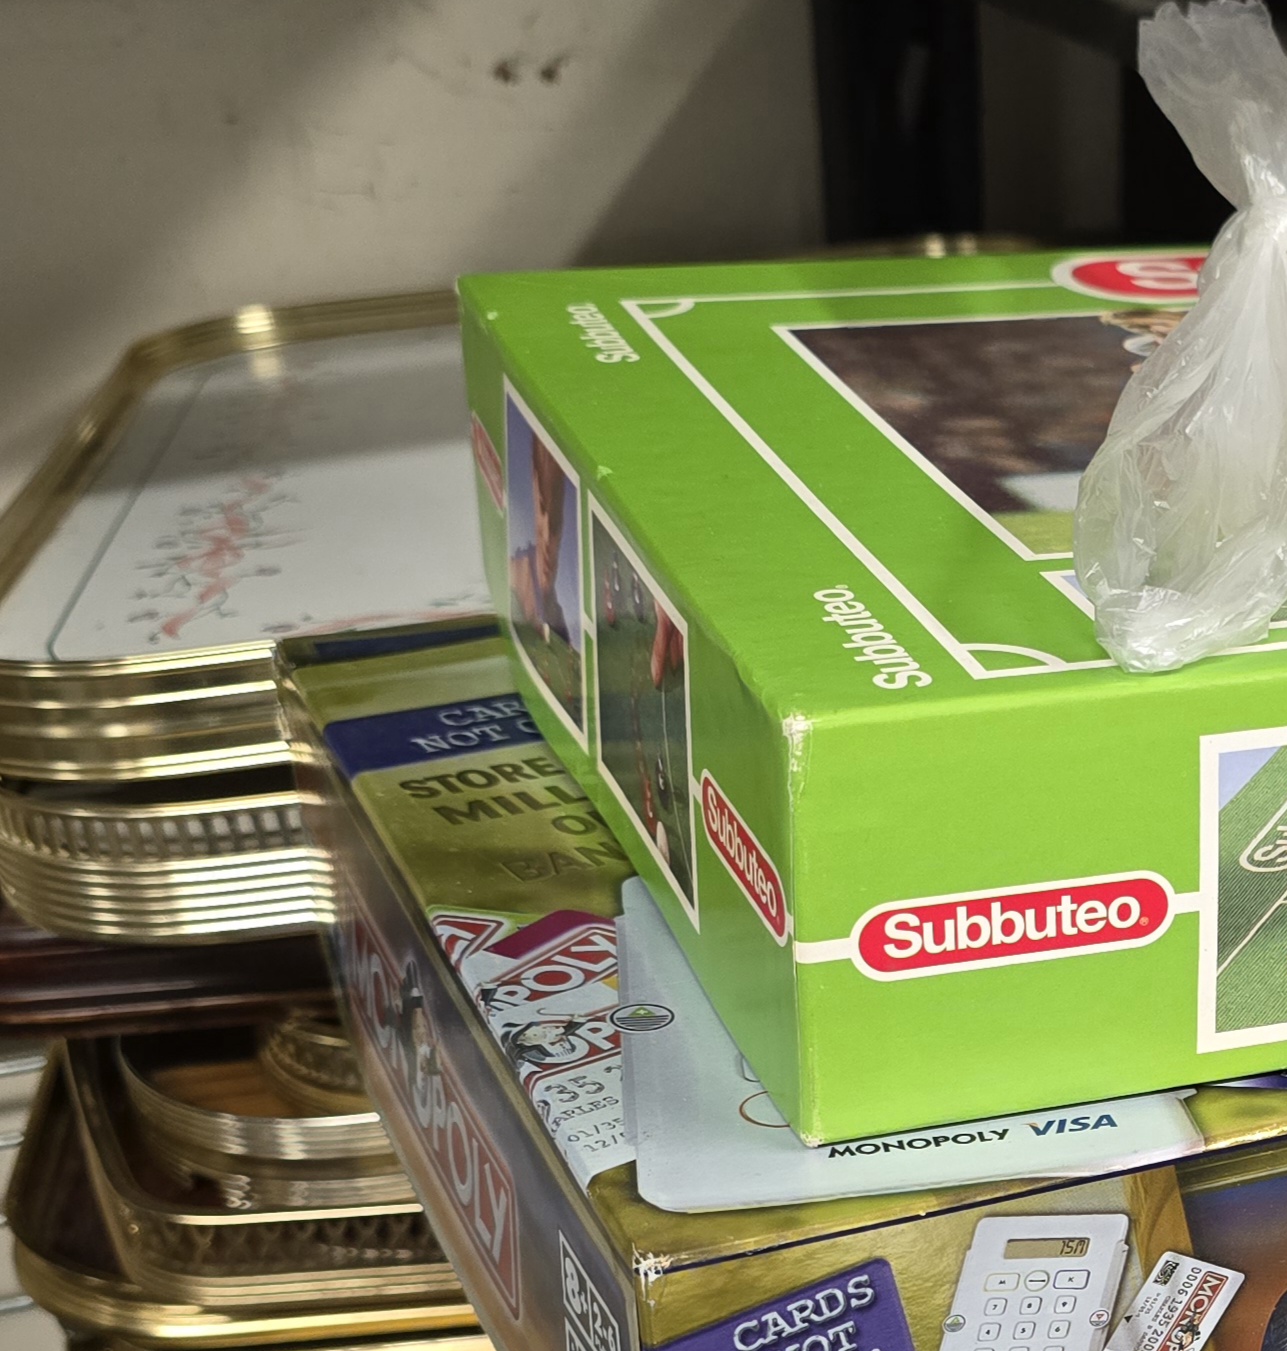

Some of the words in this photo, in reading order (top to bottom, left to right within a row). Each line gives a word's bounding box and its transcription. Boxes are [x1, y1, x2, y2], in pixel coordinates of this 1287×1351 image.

[566, 303, 640, 363] Subbuteo
[812, 584, 932, 691] Subbuteo
[440, 700, 527, 726] CAR
[410, 723, 511, 753] NOT
[400, 757, 566, 800] STORE
[433, 785, 591, 826] MILL
[502, 841, 628, 882] BAN
[707, 785, 778, 919] Subbuteo
[882, 895, 1144, 959] Subbuteo
[828, 1128, 1010, 1158] MONOPOLY
[1026, 1113, 1119, 1137] VISA
[1177, 1266, 1202, 1297] 0006
[1155, 1297, 1178, 1331] 1935
